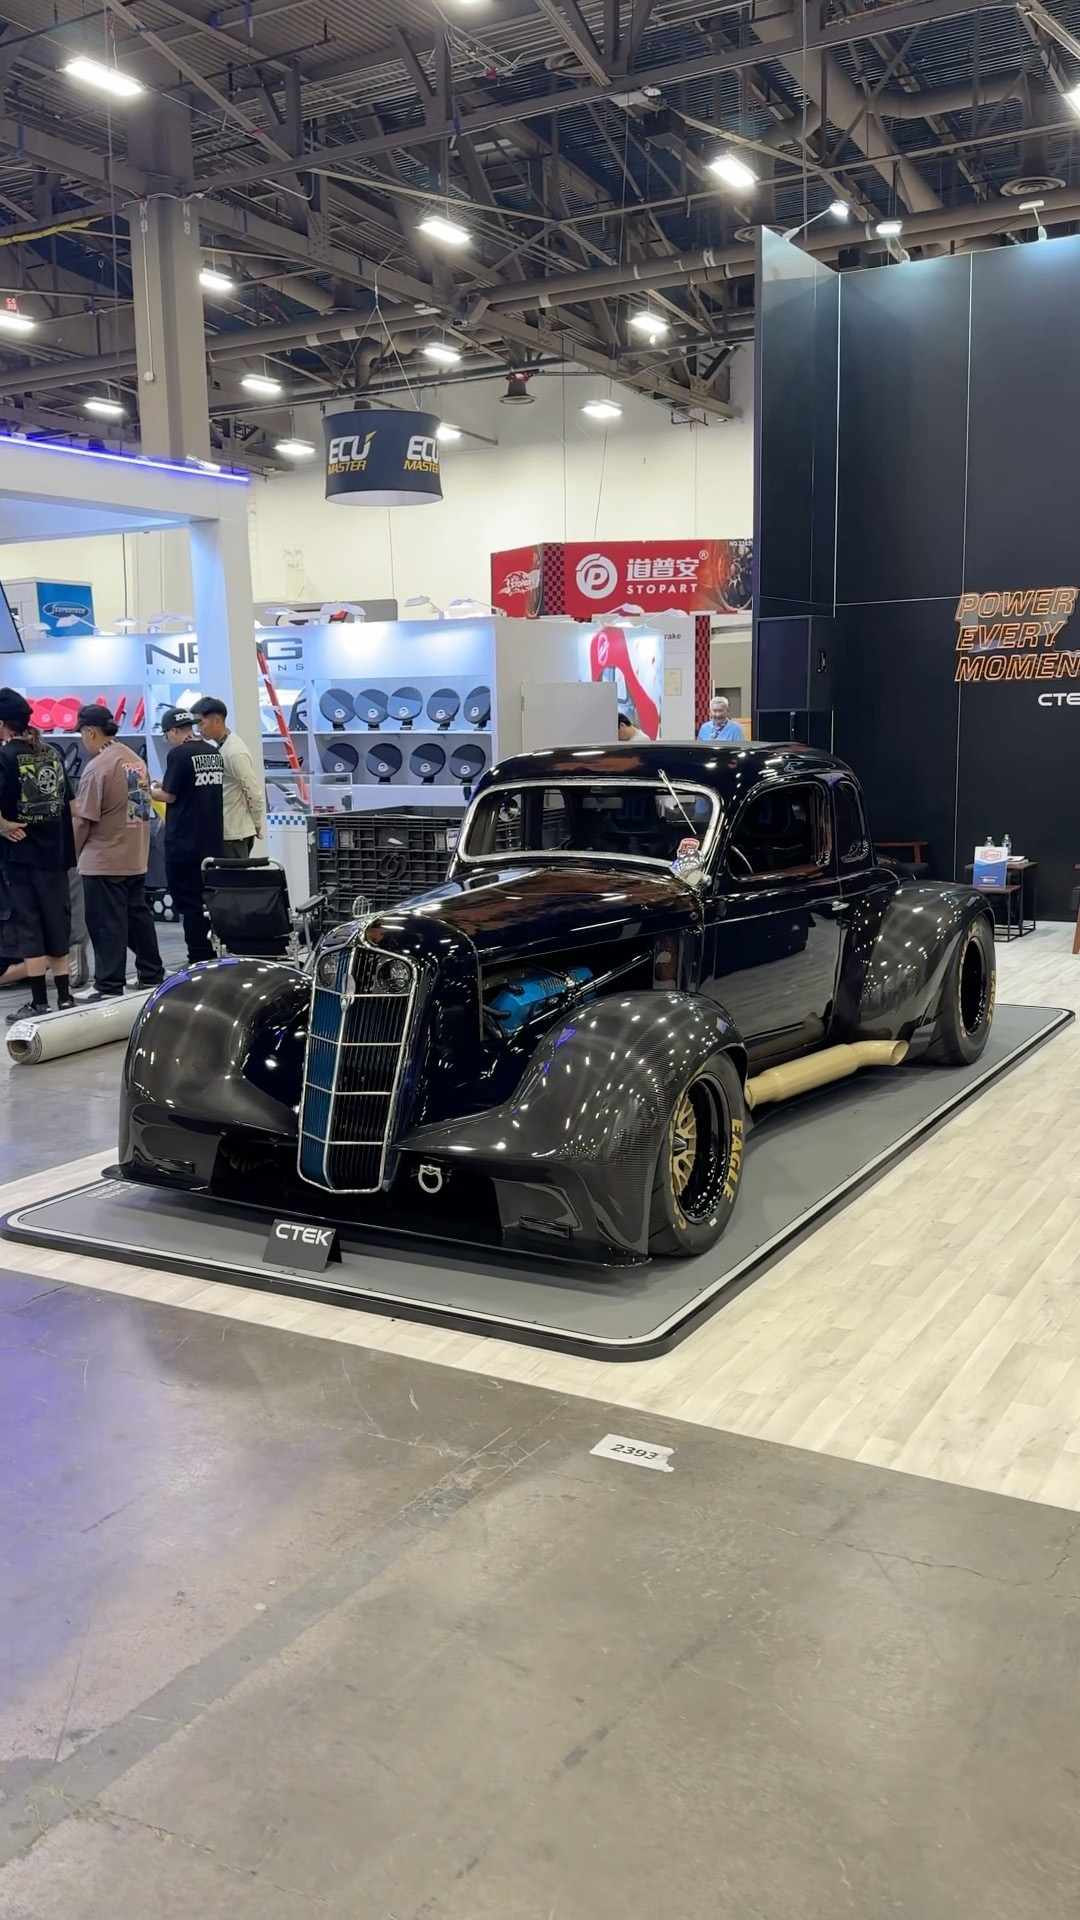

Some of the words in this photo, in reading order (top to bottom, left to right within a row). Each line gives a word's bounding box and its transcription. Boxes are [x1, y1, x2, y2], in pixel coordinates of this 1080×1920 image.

[329, 432, 375, 463] ECU
[406, 435, 439, 463] ECU
[328, 460, 367, 475] MASTER
[404, 460, 440, 474] MASTE
[626, 557, 699, 581] 道普安
[626, 584, 697, 594] STOPART
[955, 587, 1078, 620] POWER
[955, 620, 1066, 651] EVERY
[145, 637, 304, 665] NG
[722, 1118, 743, 1204] EAGLE
[275, 1223, 332, 1246] CTEK
[610, 1443, 658, 1460] 2393
